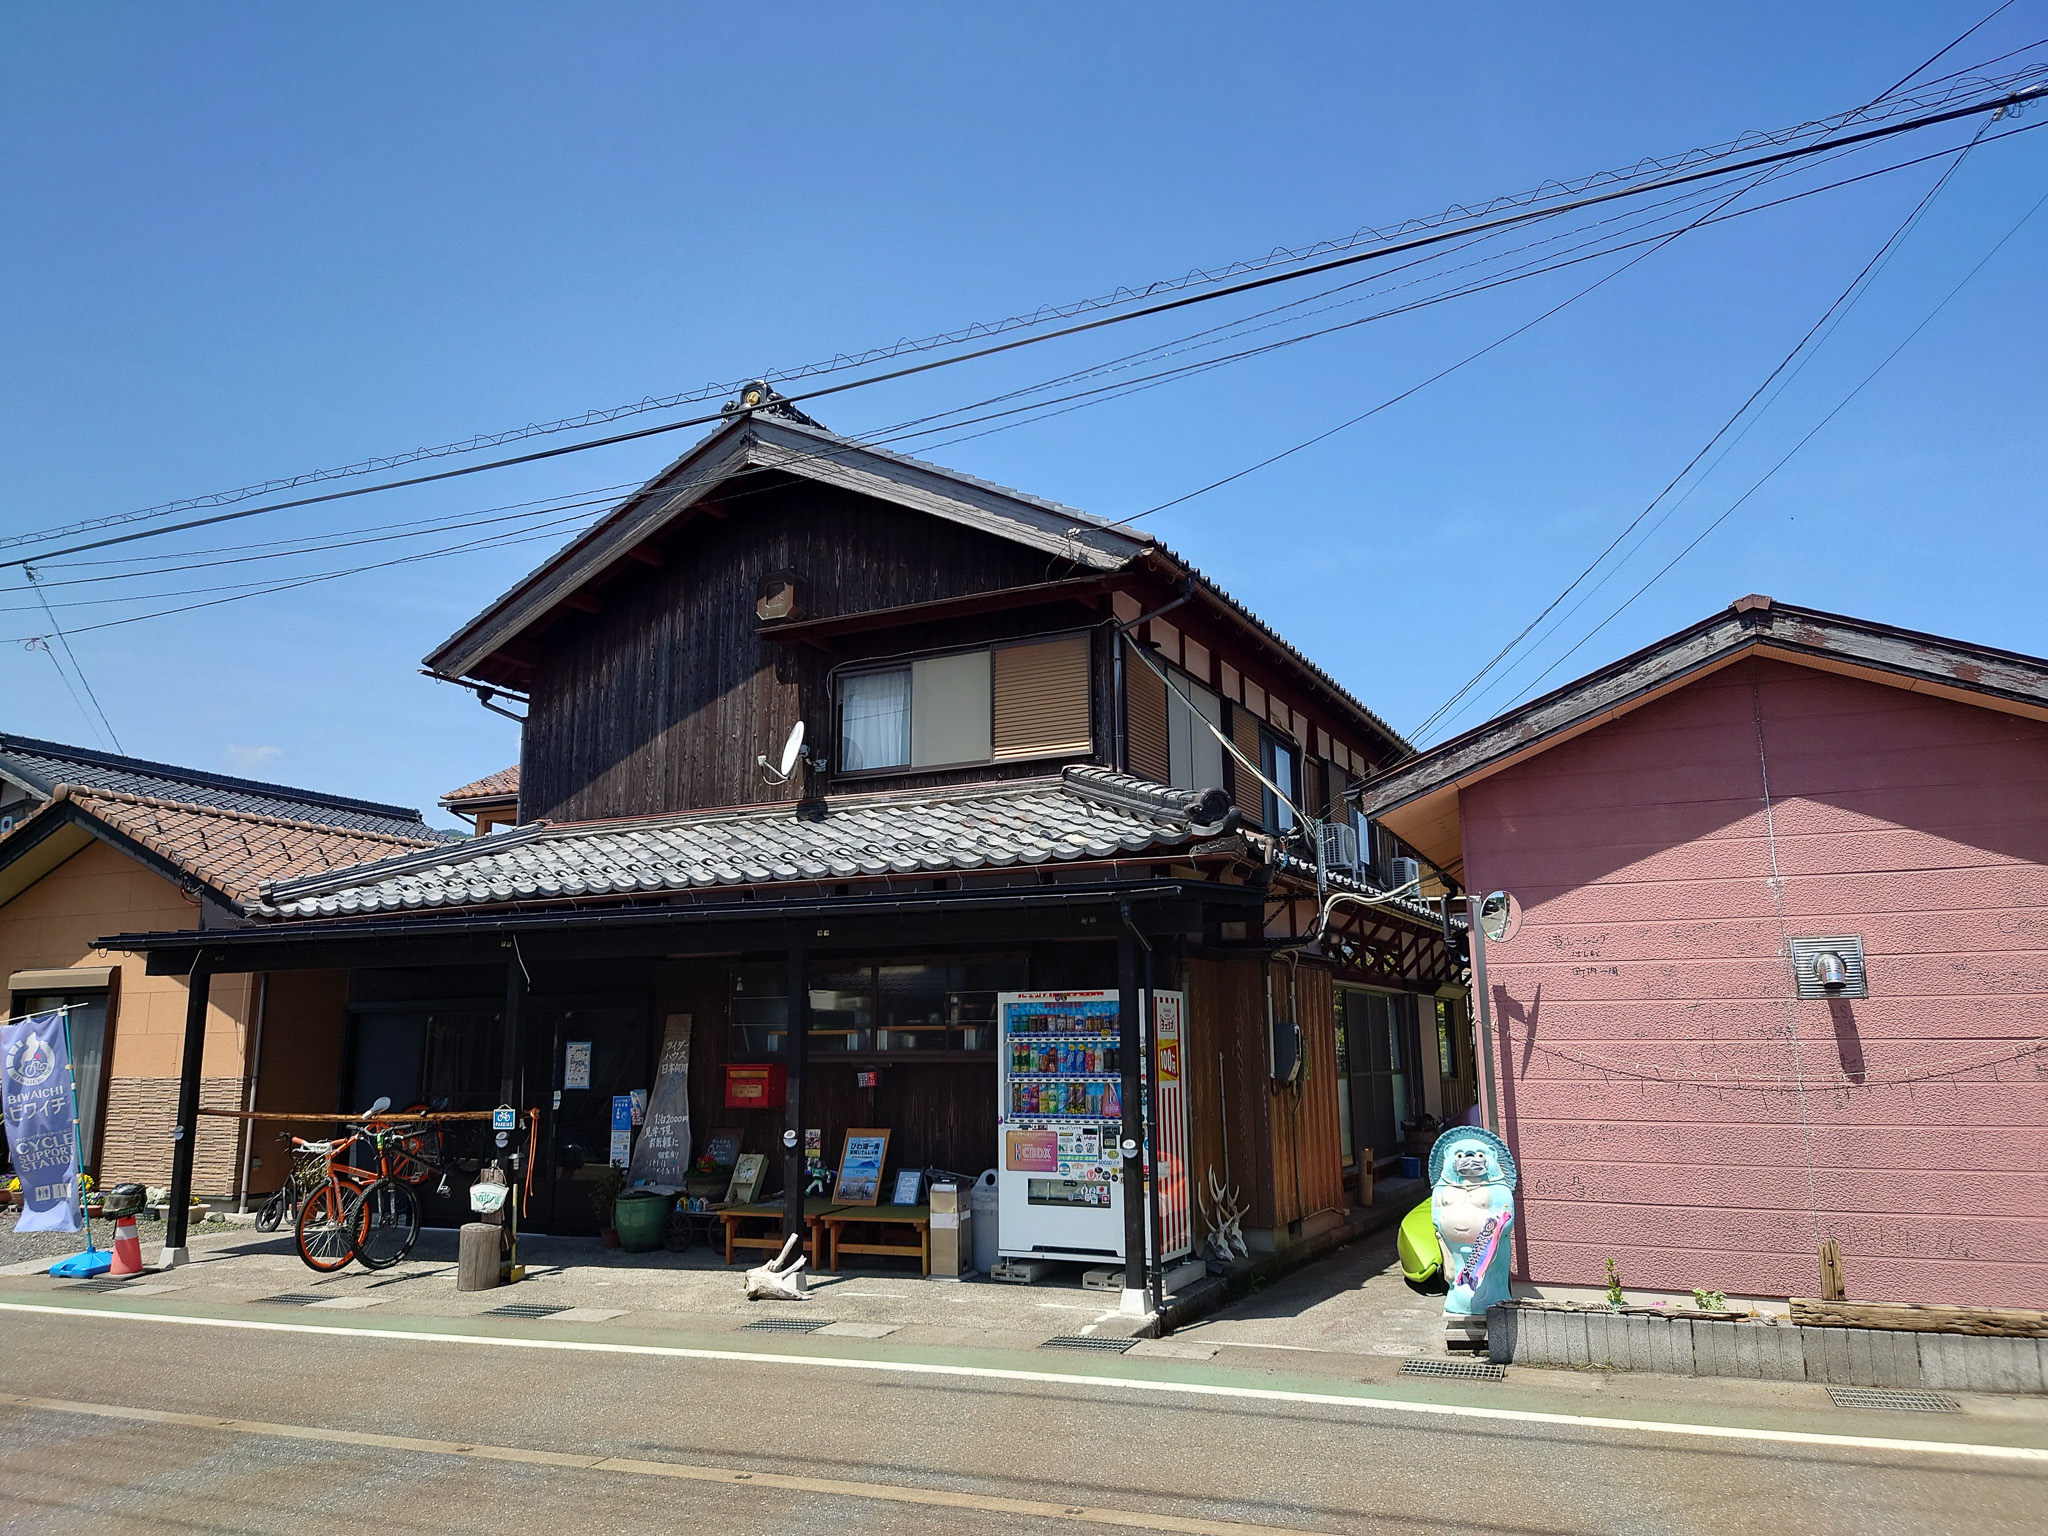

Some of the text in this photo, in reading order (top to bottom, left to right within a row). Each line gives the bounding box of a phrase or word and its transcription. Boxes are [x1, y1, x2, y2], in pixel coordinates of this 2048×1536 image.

[663, 1050, 687, 1062] ハウス
[8, 1085, 64, 1104] BIWAICHI
[9, 1097, 66, 1121] ビワイチ
[15, 1132, 75, 1155] CYCLE
[18, 1145, 74, 1164] SUPPORT
